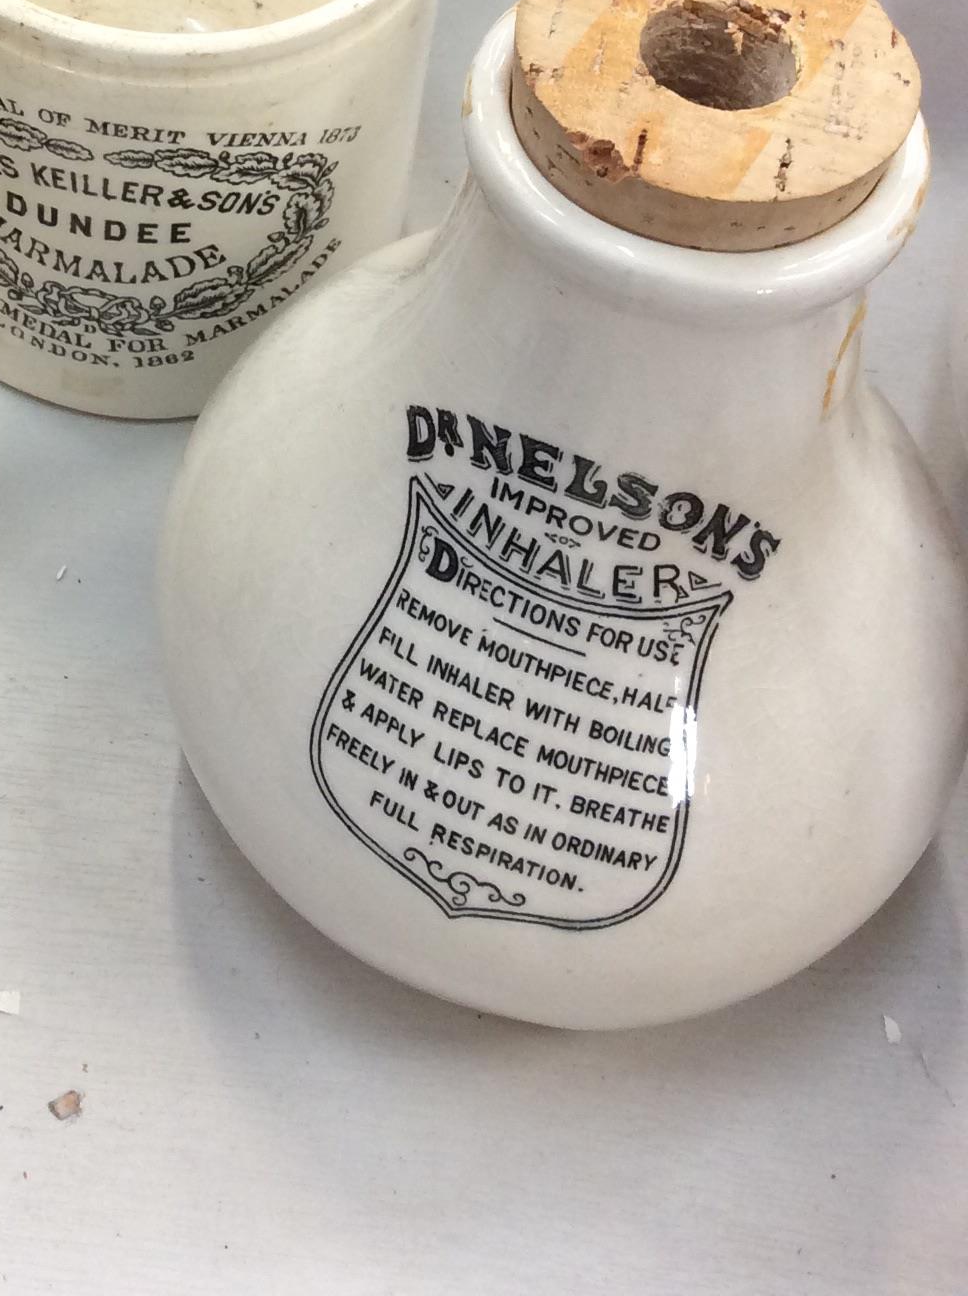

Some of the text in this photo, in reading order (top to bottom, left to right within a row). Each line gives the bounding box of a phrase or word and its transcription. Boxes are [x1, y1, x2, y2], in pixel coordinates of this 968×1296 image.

[38, 108, 71, 127] OF
[84, 117, 185, 145] MERIT
[207, 132, 307, 147] VIENNA
[317, 125, 362, 144] 1873
[6, 191, 192, 244] DUNDEE
[0, 298, 93, 349] MEDAL
[108, 337, 169, 353] FOR
[185, 237, 342, 346] MARMALADE
[134, 350, 194, 368] 1862
[450, 488, 689, 603] INHALER
[466, 414, 781, 581] NELSON'S
[490, 477, 661, 551] IMPROVED
[396, 588, 473, 646] REMOVE
[426, 537, 684, 666] DIRECTIONS FOR USE
[359, 657, 669, 797] WATER REPLACE MOUTHPIECE
[378, 625, 672, 757] FILL INHALER WITH BOILING
[326, 723, 396, 774] FREELY
[398, 767, 419, 791] IN
[487, 812, 519, 835] AS
[523, 823, 547, 844] IN
[551, 832, 658, 871] ORDINARY
[341, 689, 356, 712] &
[360, 703, 425, 748] APPLY
[433, 741, 484, 779] LIPS
[496, 766, 526, 794] TO
[569, 795, 670, 834] BREATHE
[369, 790, 584, 891] FULL RESPIRATION.
